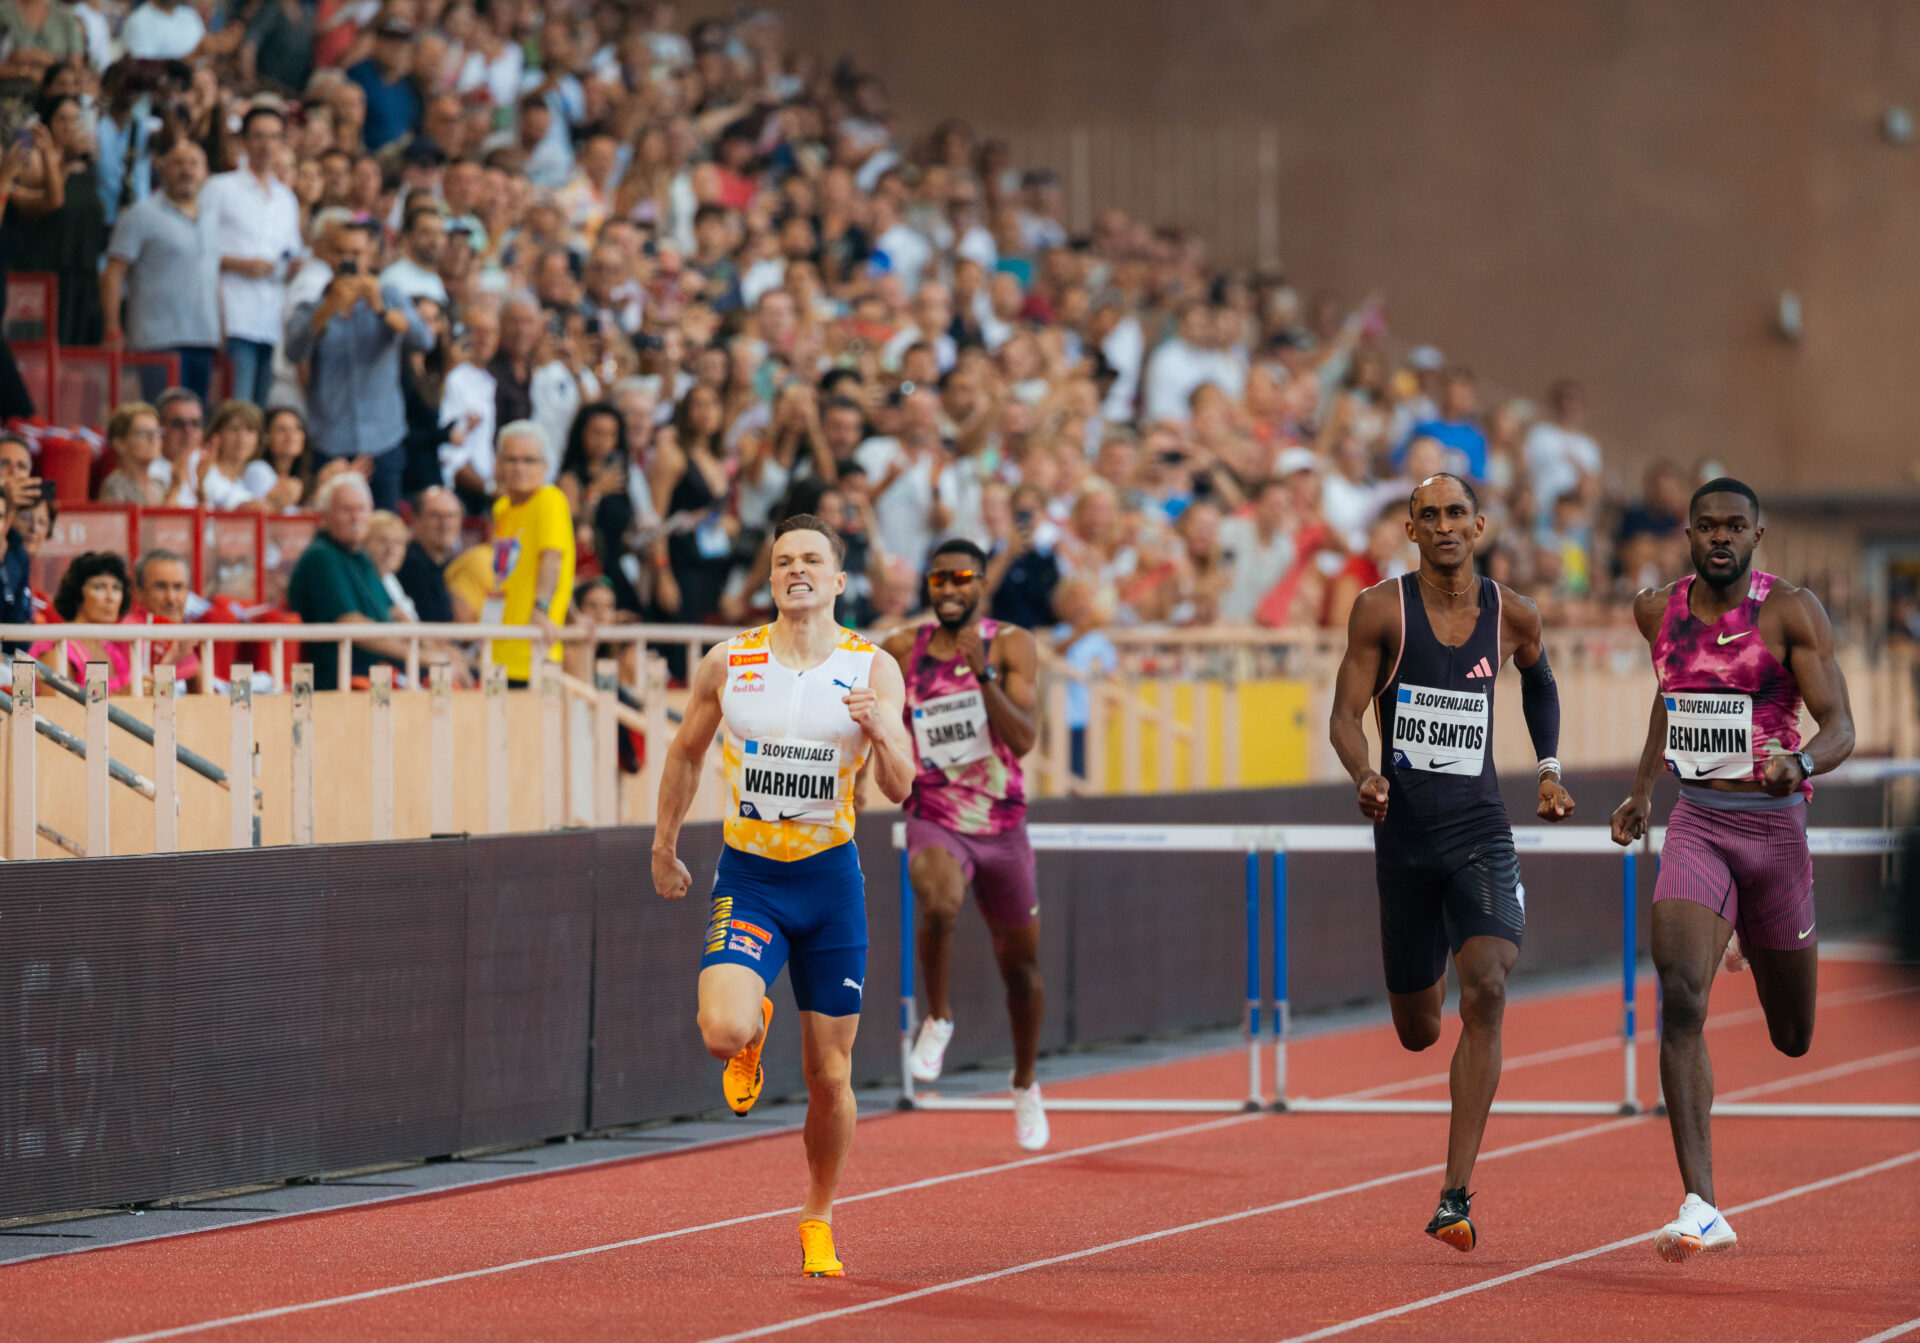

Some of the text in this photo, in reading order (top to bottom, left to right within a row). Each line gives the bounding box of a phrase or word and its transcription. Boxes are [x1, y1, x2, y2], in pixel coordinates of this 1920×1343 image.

[743, 655, 766, 664] EXTRA
[732, 684, 765, 693] Red Bull
[1414, 692, 1484, 712] SLOVENIJALES
[1679, 698, 1745, 715] SLOVENIJALES
[927, 720, 977, 747] SAMBA
[1396, 716, 1484, 750] DOS SANTOS
[1669, 725, 1747, 753] BENJAMIN
[761, 743, 835, 762] SLOVENIJALES
[744, 767, 835, 800] WARHOLM
